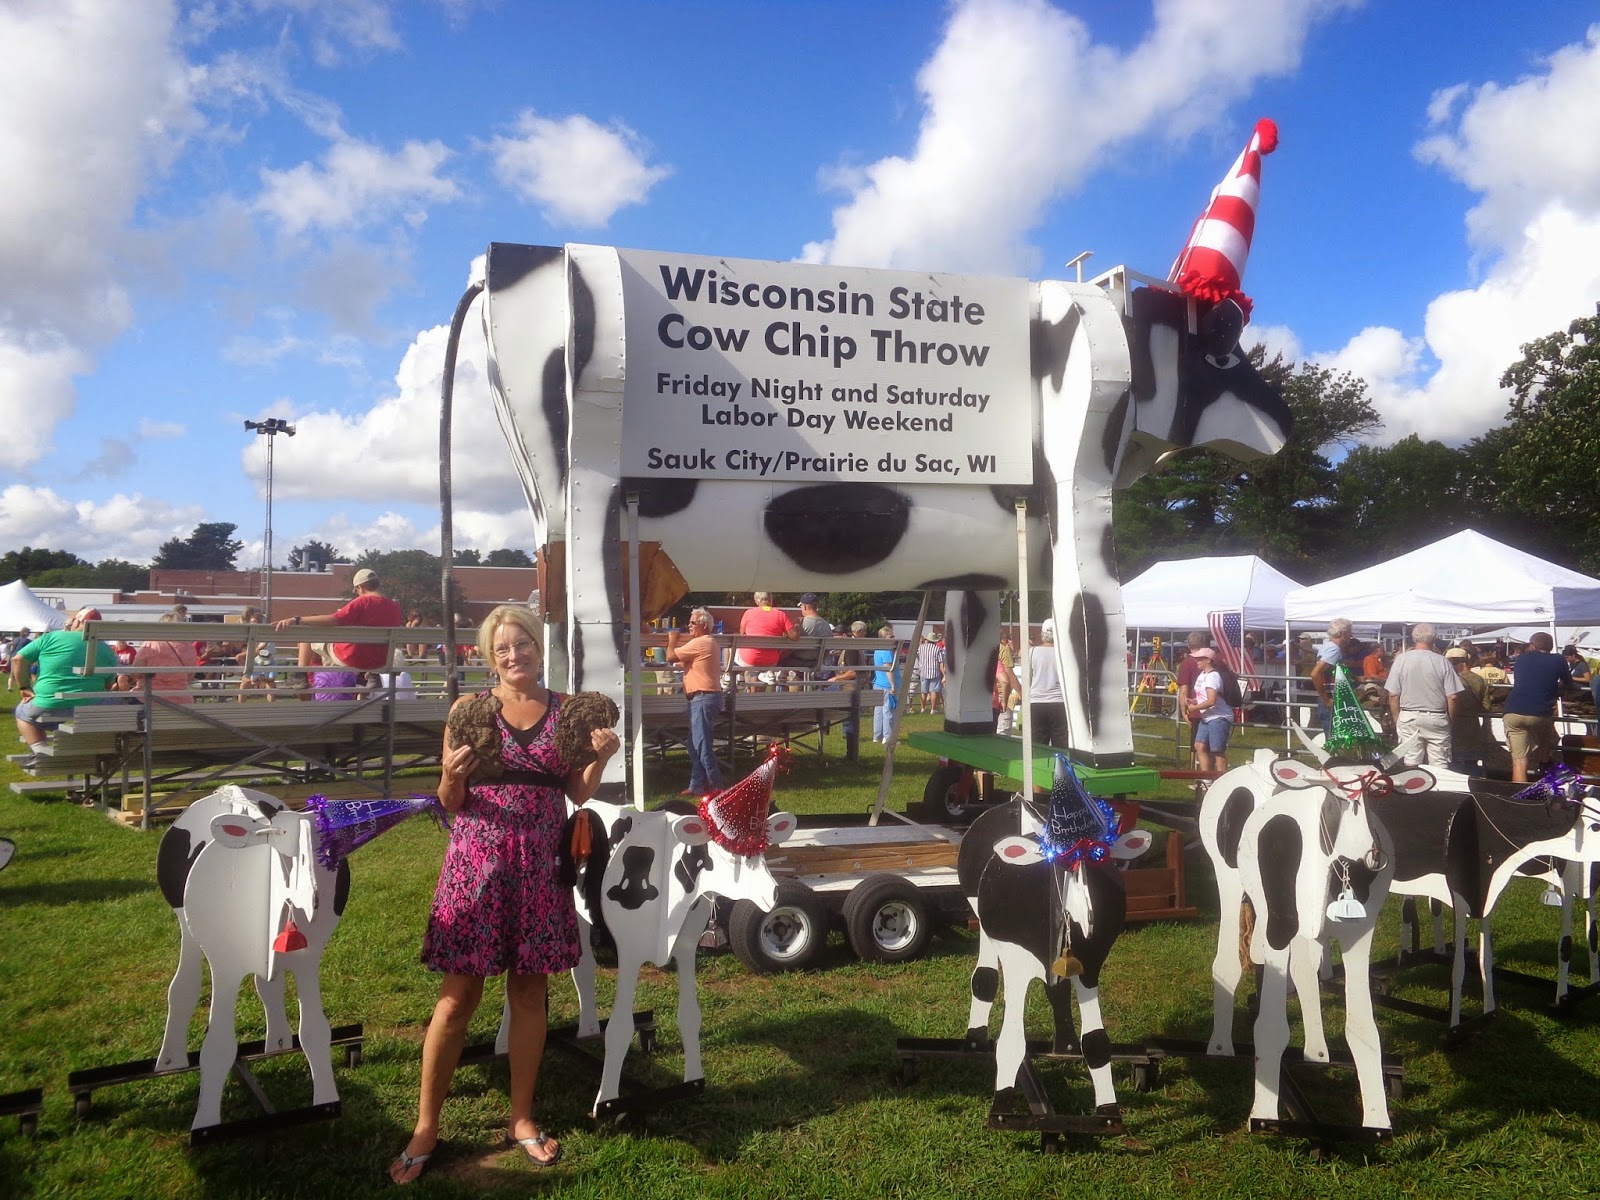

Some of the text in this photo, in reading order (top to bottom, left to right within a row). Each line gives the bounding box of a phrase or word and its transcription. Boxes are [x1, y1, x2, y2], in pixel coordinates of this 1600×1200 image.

[659, 265, 986, 325] Wisconsin State
[657, 314, 991, 368] Cow Chip Throw
[657, 373, 991, 413] Friday Night and Saturday
[702, 404, 954, 434] Labor Day Weekend
[647, 448, 997, 476] Sauk City/Prairie du Sac, WI
[1051, 817, 1097, 835] Birthday
[1053, 804, 1089, 820] Happy
